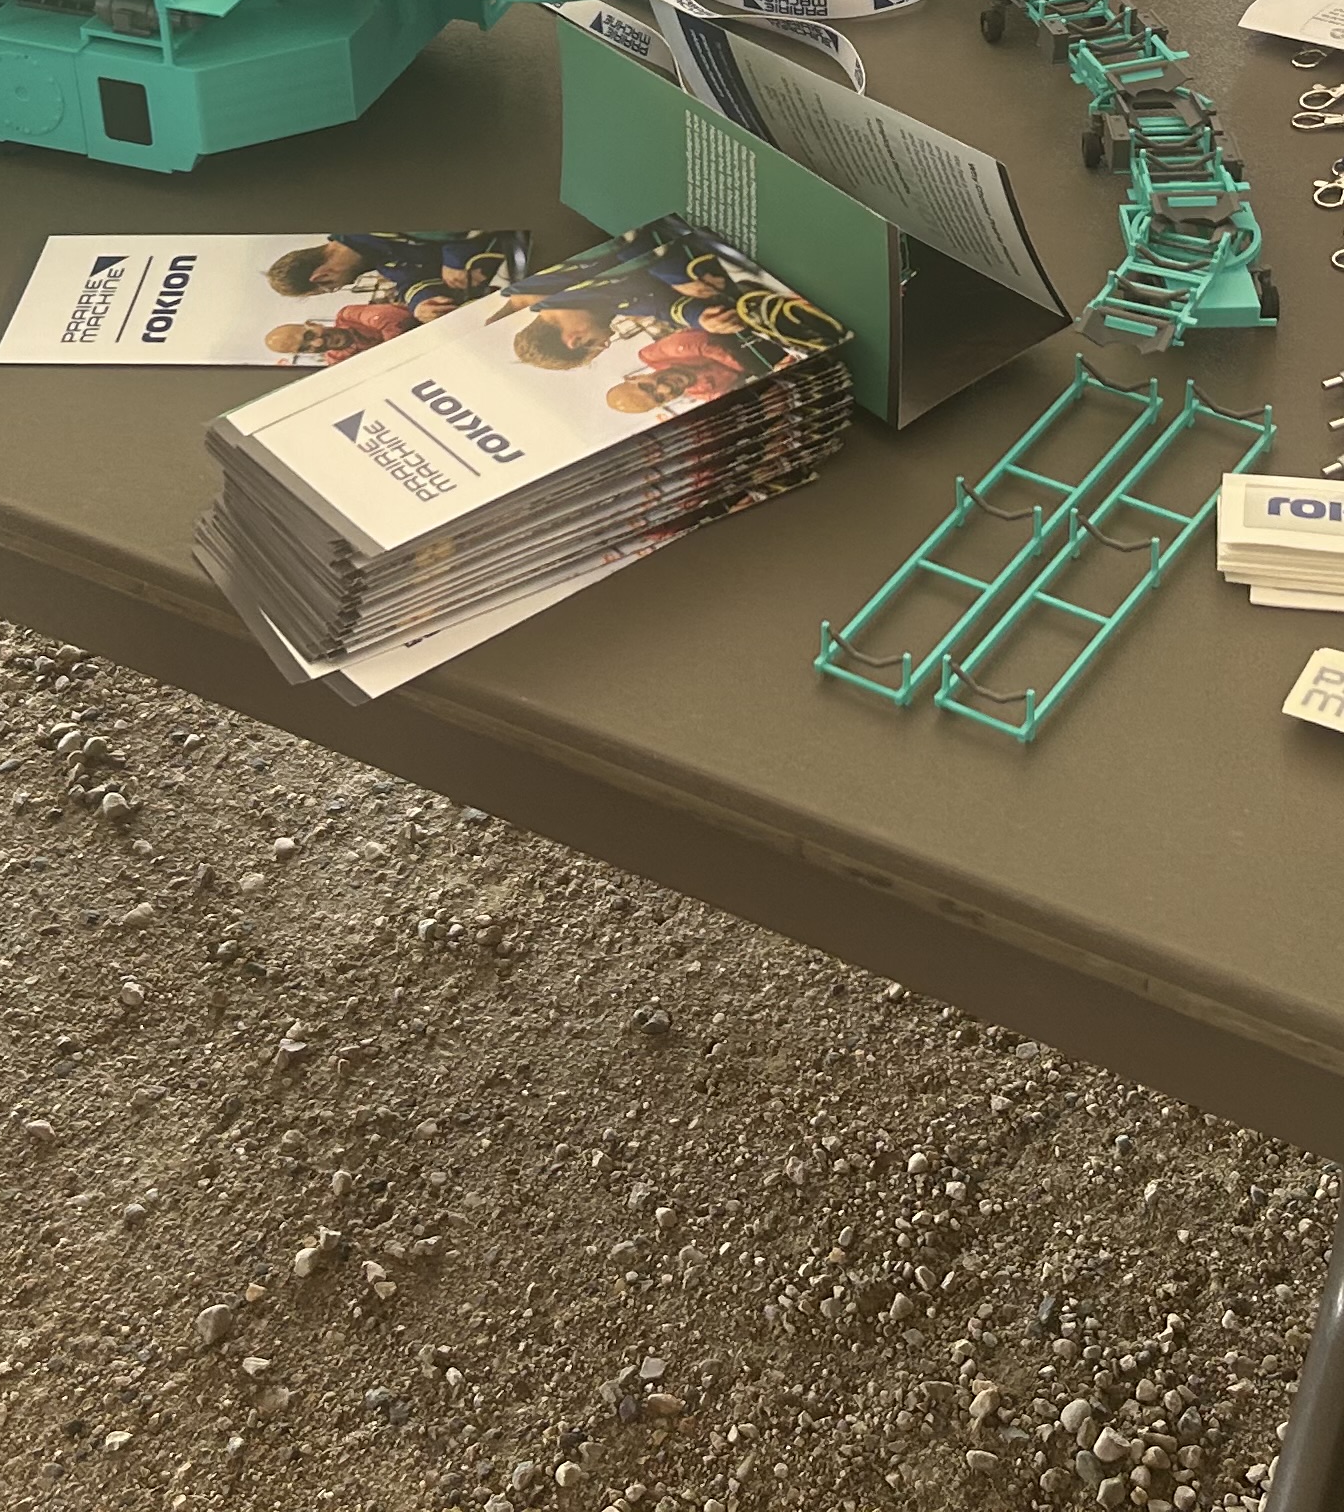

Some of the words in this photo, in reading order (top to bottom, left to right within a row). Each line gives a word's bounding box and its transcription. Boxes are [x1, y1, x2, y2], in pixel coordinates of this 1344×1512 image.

[603, 15, 652, 46] MACHINE
[765, 2, 828, 17] PRAIRIE
[61, 279, 103, 343] PRAIRIE
[79, 268, 125, 343] MACHINE
[142, 255, 198, 343] rokion
[411, 379, 525, 463] rokion
[358, 438, 439, 502] PRAIRIE
[363, 420, 457, 493] MACHINE
